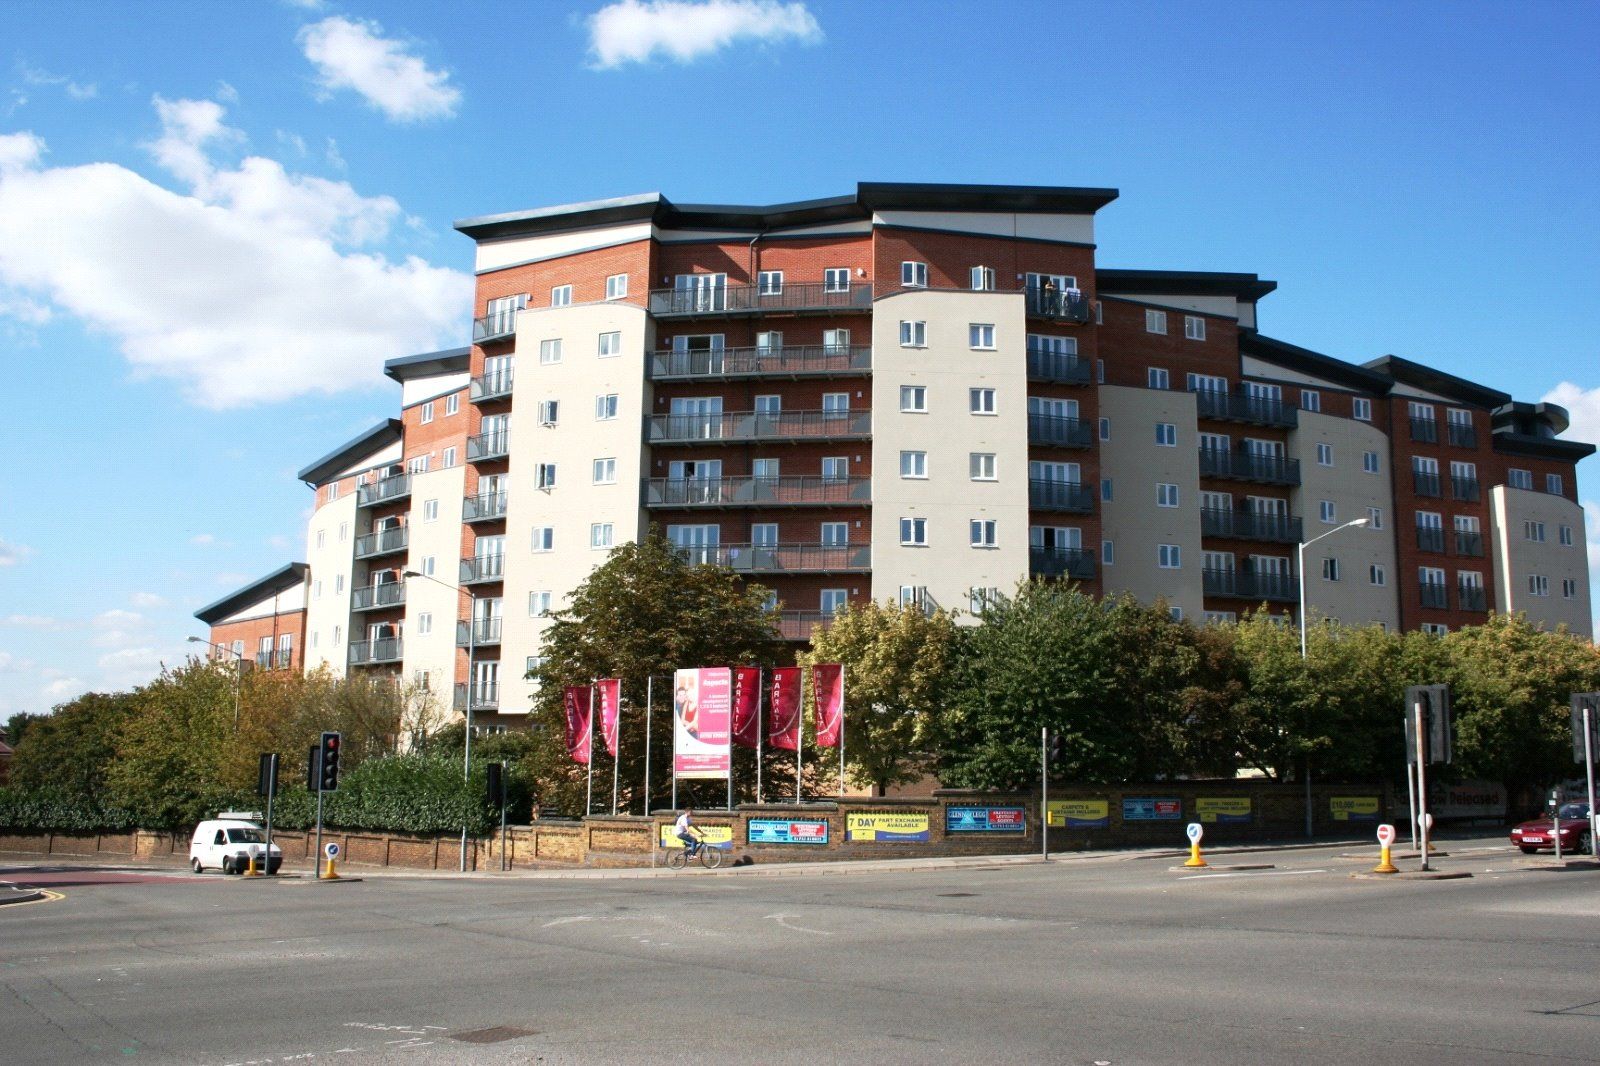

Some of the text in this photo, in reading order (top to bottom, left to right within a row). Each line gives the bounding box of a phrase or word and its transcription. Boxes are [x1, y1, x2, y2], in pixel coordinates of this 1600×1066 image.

[567, 692, 575, 745] BARRATT
[733, 673, 744, 734] BARRATT
[773, 674, 782, 729] BARRATT
[816, 671, 824, 726] BARRATT
[849, 818, 876, 827] 7 DAY
